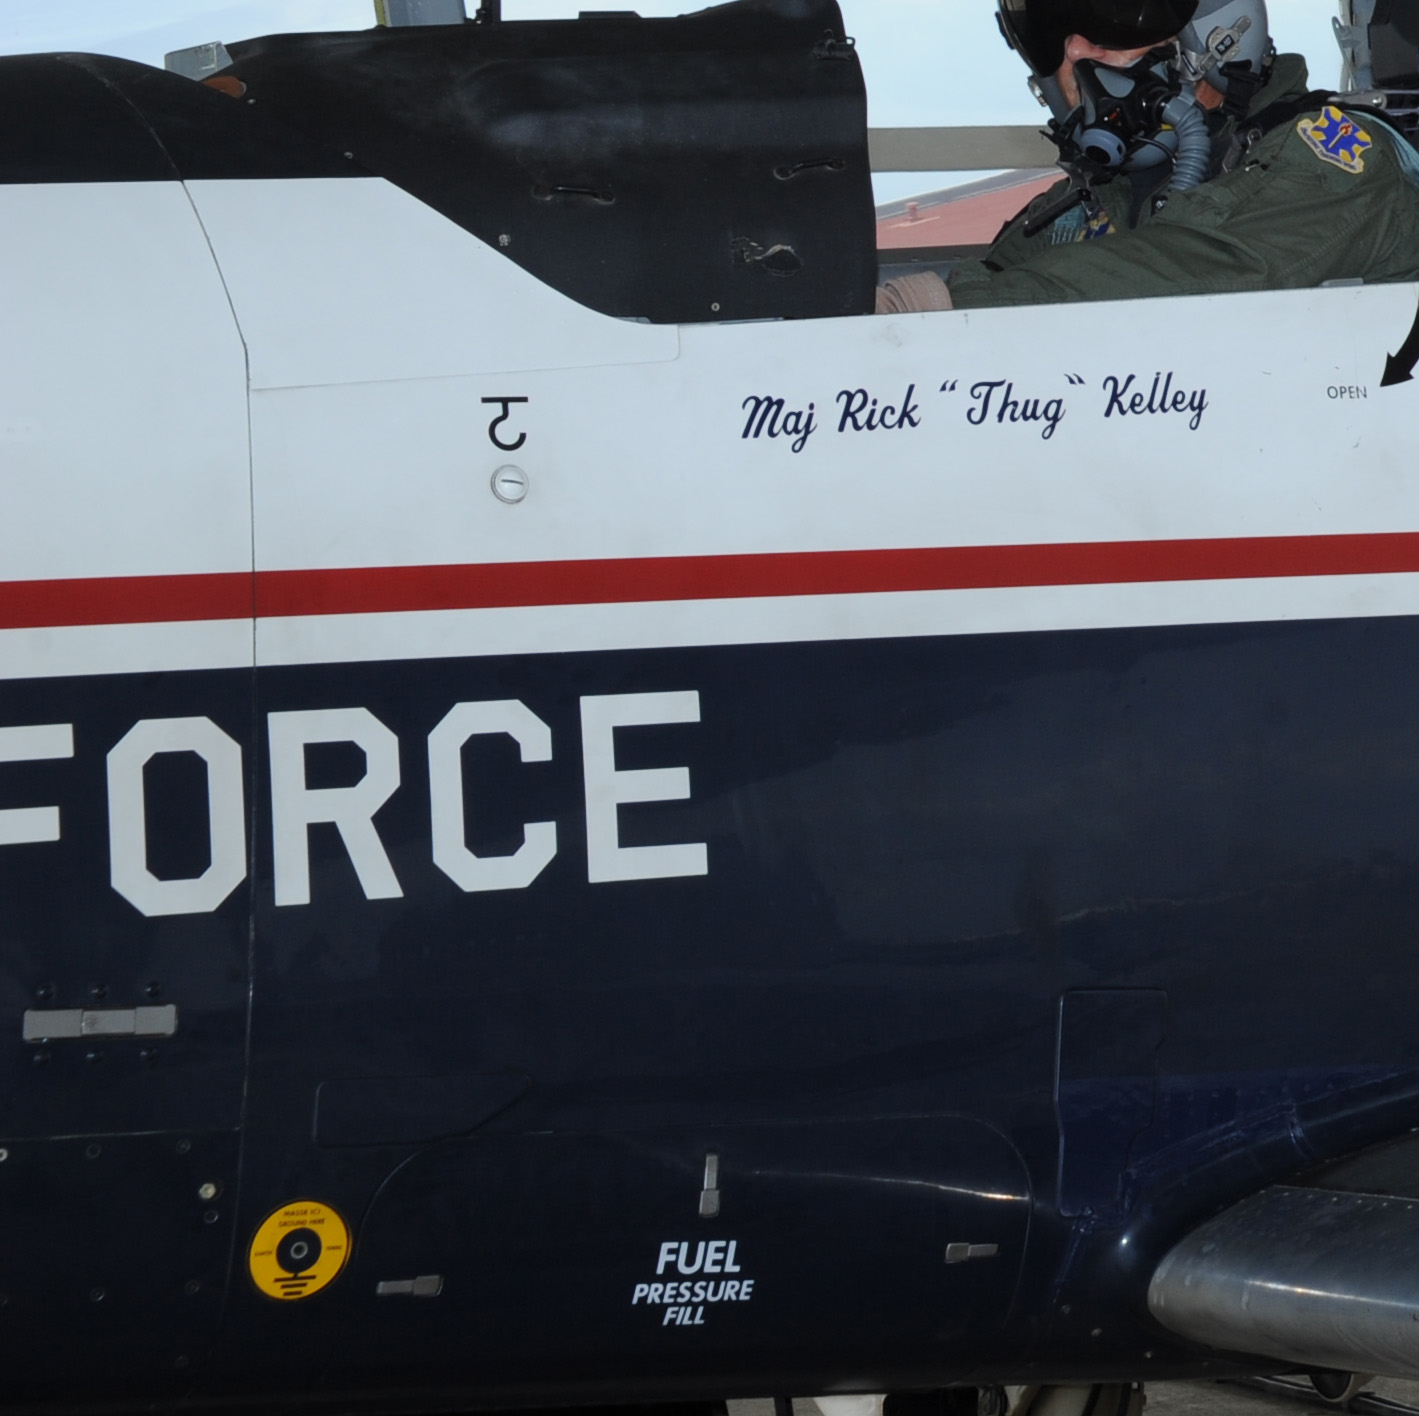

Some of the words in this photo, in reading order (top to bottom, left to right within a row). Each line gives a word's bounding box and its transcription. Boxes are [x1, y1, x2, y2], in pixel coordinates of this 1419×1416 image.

[1326, 385, 1368, 400] OPEN
[741, 395, 817, 453] Maj
[836, 384, 921, 433] Rick
[1102, 371, 1208, 431] Kelley
[656, 1240, 741, 1275] FUEL
[632, 1279, 755, 1305] PRESSURE
[662, 1304, 705, 1326] FILL
